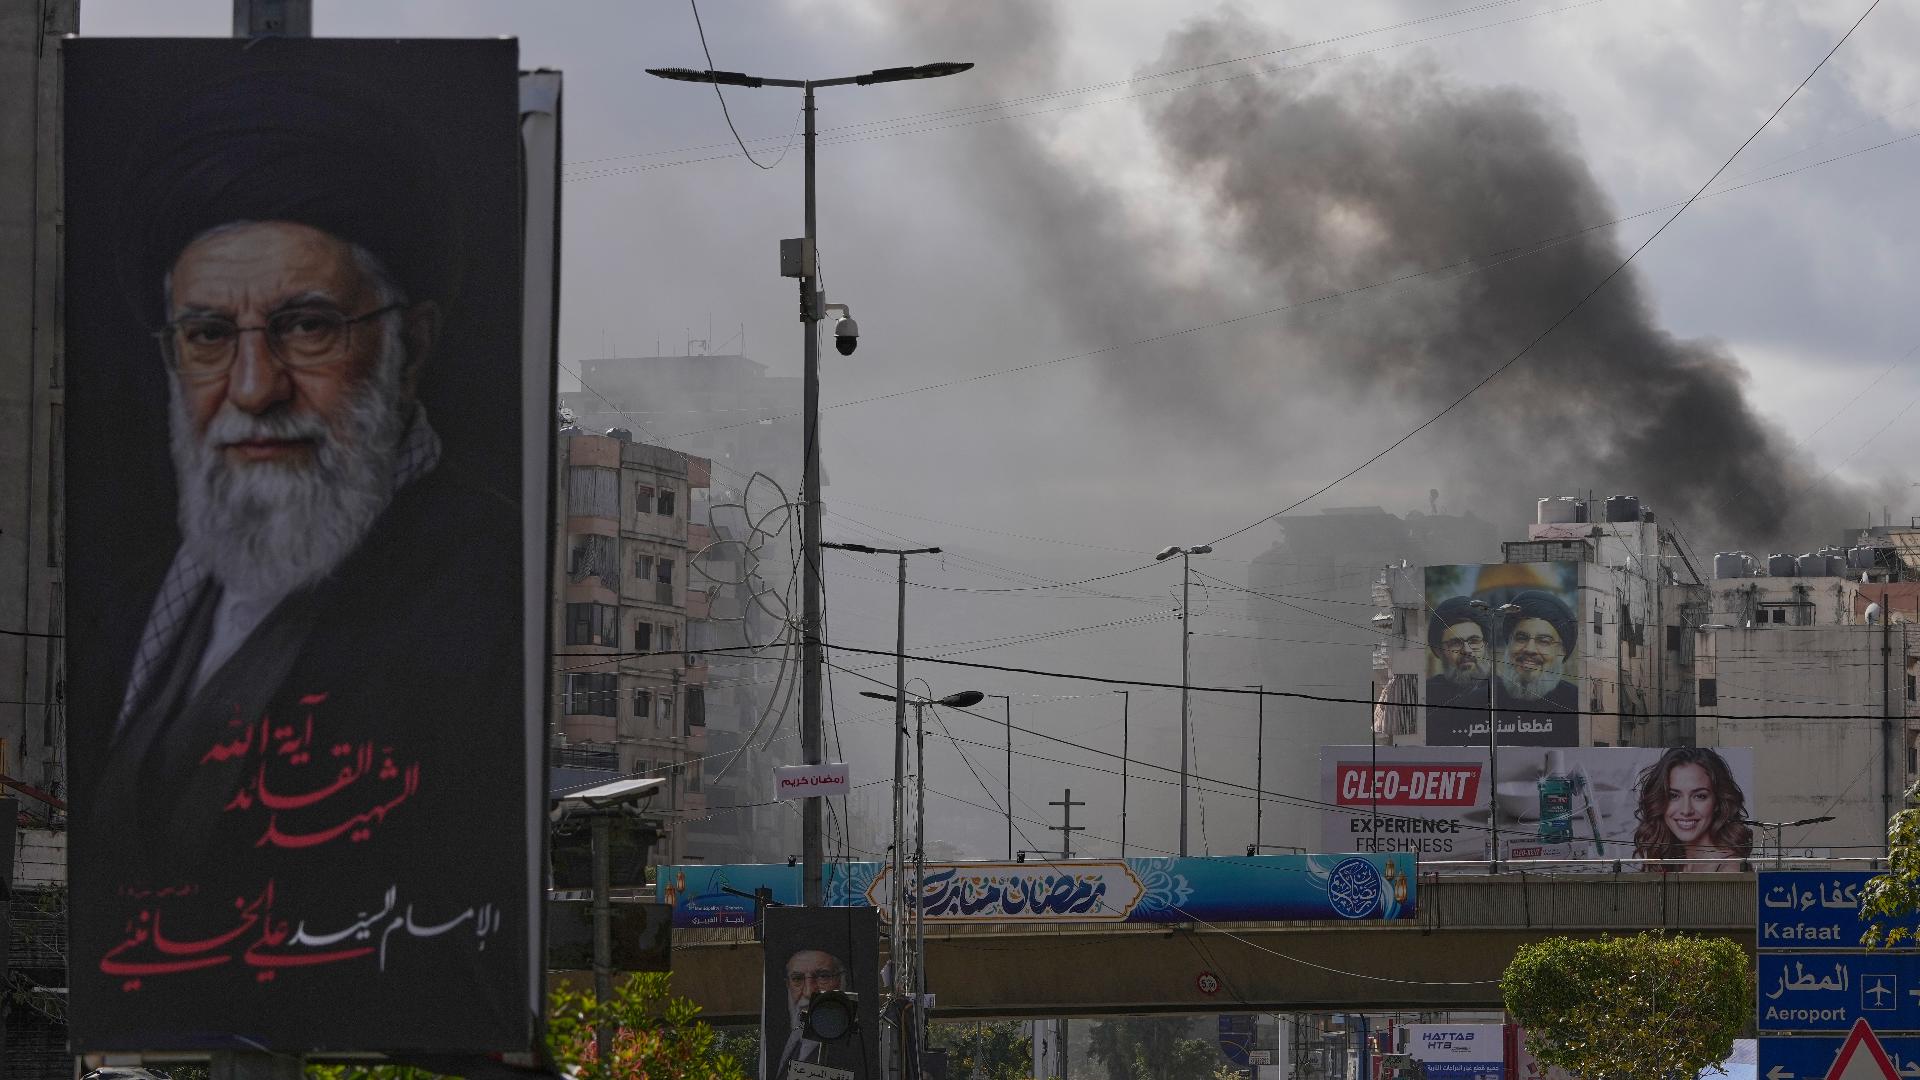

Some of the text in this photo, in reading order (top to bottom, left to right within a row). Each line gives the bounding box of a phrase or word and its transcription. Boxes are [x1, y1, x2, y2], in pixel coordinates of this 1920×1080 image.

[271, 692, 328, 766] آية
[781, 774, 844, 788] رمضان كريم
[1342, 769, 1471, 800] CLEO-DENT
[1350, 817, 1460, 834] EXPERIENCE
[1356, 837, 1453, 853] FRESHNESS
[998, 874, 1106, 915] رمضان
[1764, 922, 1841, 940] Kafaat
[244, 914, 376, 983] علي
[1765, 961, 1849, 1000] المطار
[1765, 1006, 1846, 1024] Aeroport
[1423, 1032, 1475, 1041] HATTAB
[1428, 1041, 1453, 1049] HTB
